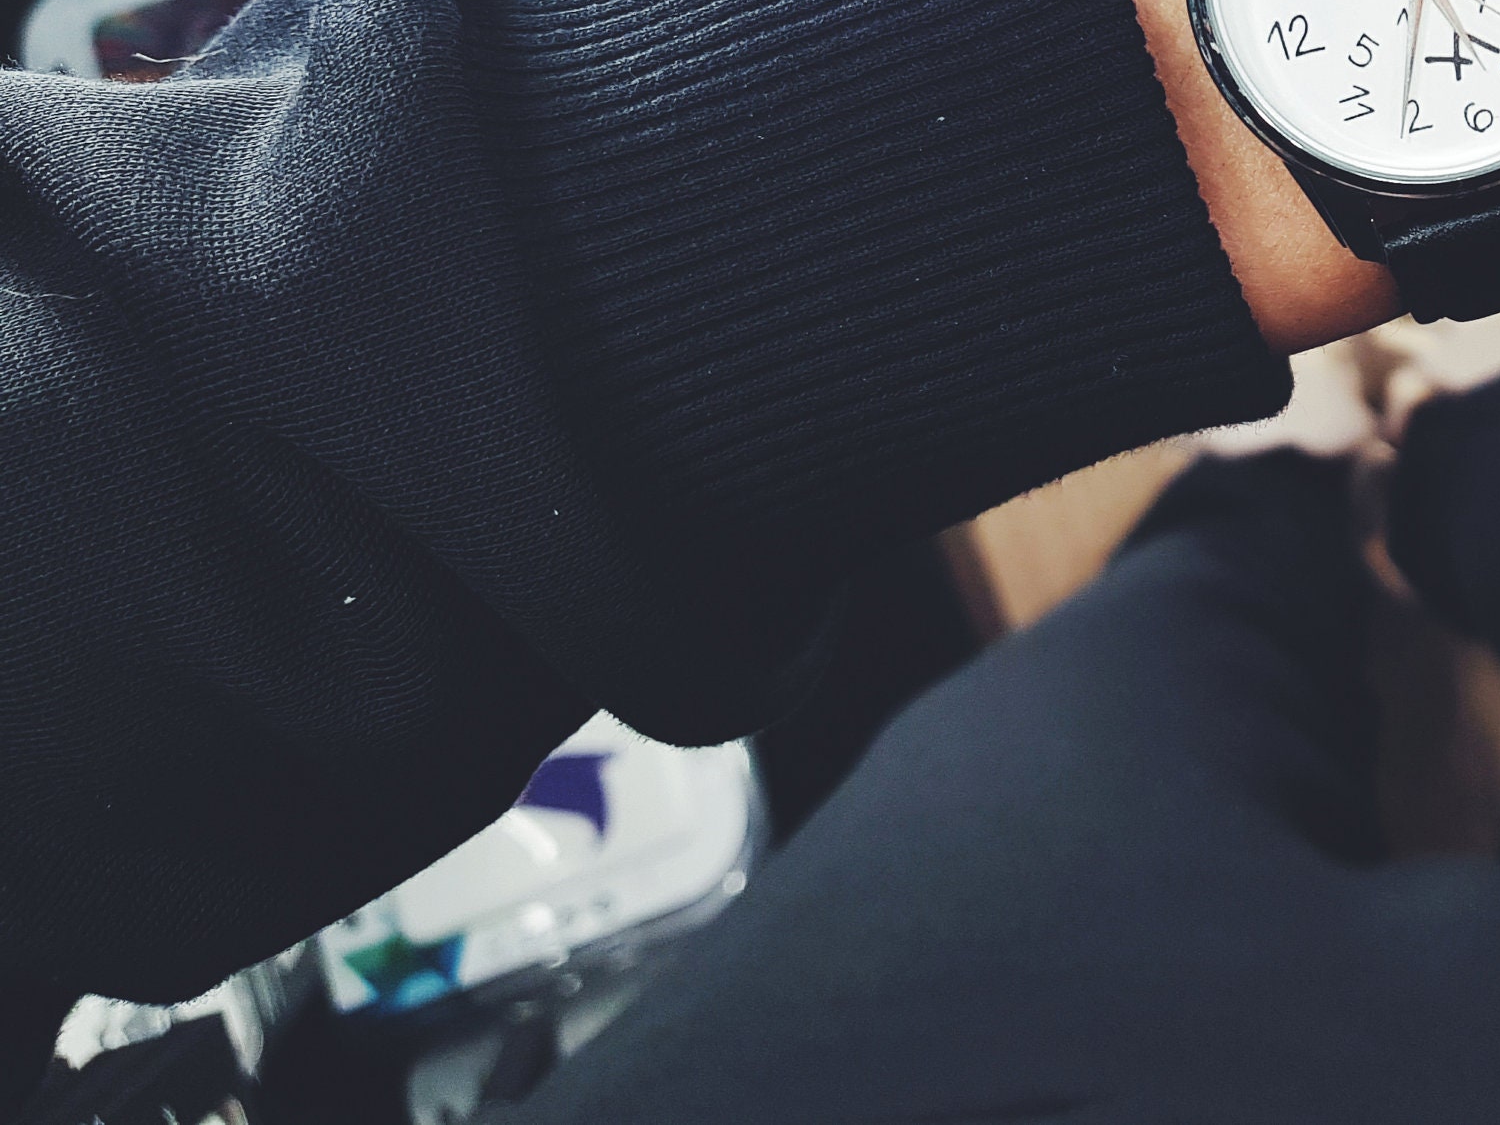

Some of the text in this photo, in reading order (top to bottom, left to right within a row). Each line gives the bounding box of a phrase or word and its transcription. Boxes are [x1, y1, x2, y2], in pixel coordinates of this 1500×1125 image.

[1267, 14, 1326, 61] 12
[1347, 33, 1380, 68] 5
[1424, 31, 1500, 81] 4
[1406, 99, 1433, 134] 2
[1464, 102, 1494, 133] 6
